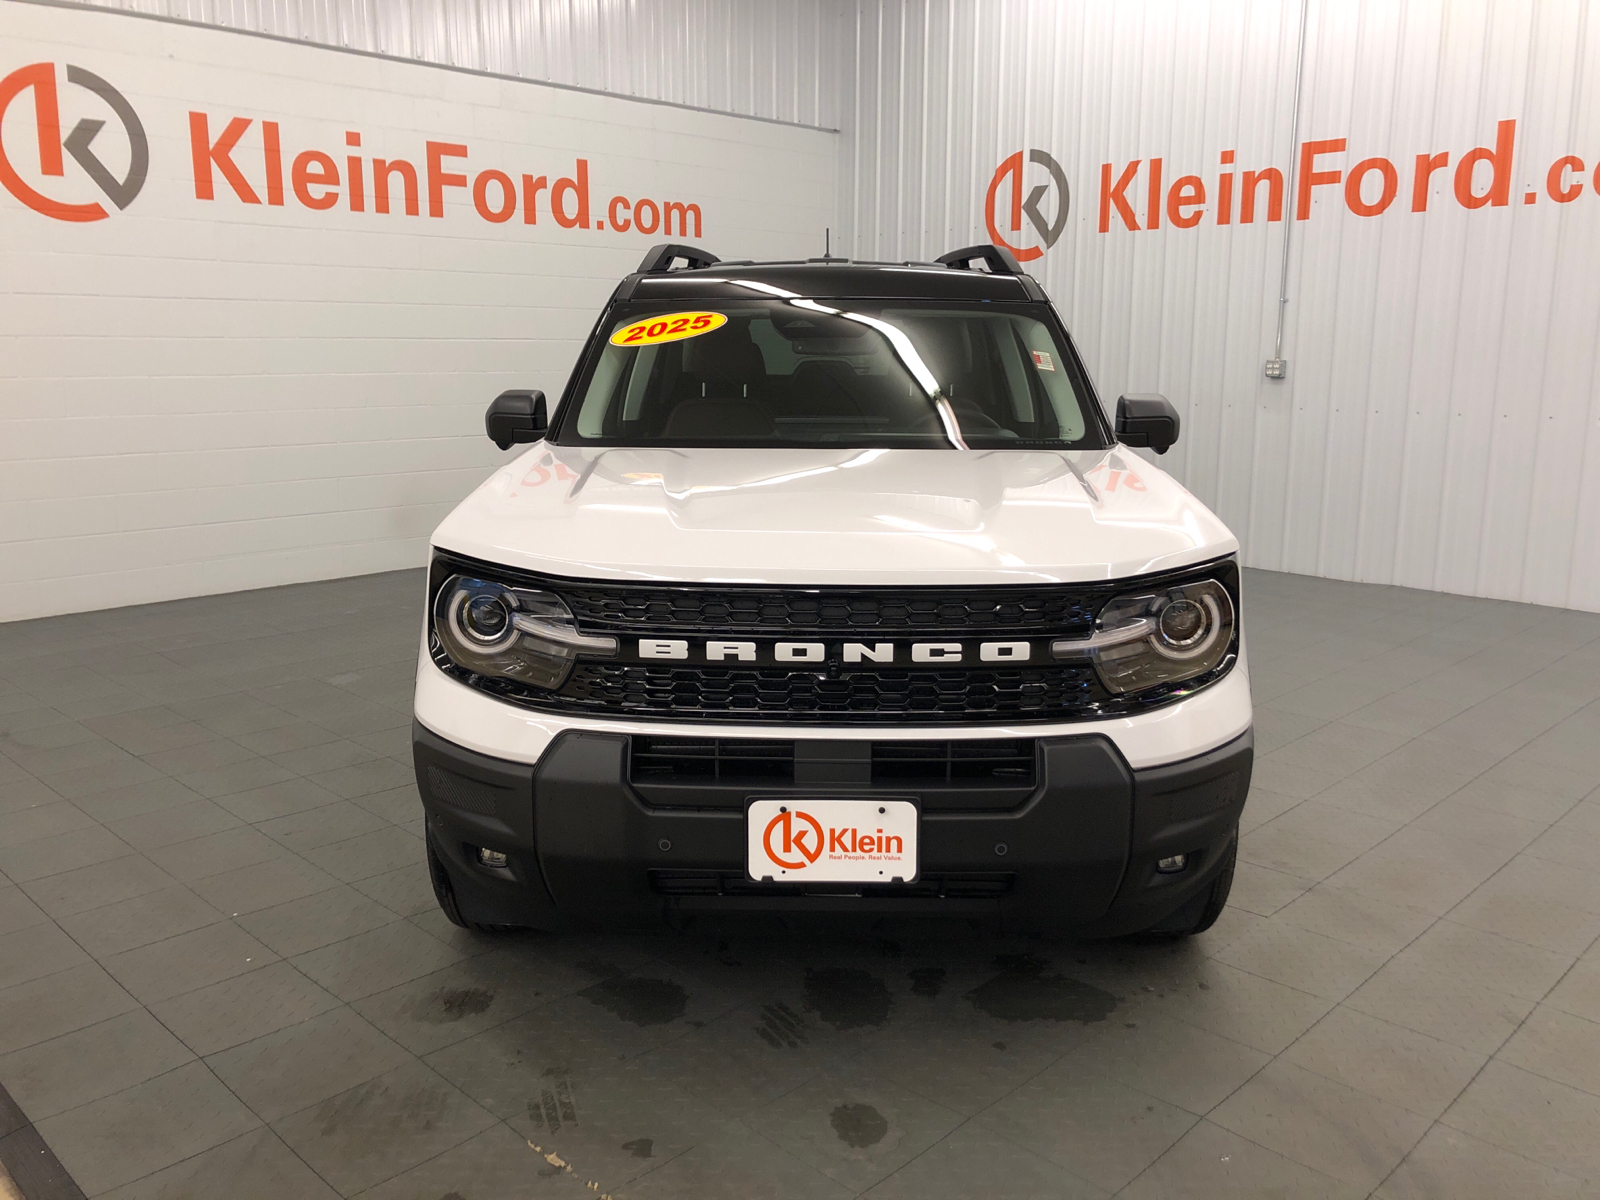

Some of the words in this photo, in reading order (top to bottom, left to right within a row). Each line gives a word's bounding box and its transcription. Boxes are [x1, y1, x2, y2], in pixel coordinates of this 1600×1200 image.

[188, 110, 703, 239] KleinFord.com
[1098, 119, 1600, 233] KleinFord.c
[623, 314, 713, 343] 2025
[638, 638, 1031, 663] BRONCO
[829, 828, 903, 853] Klein
